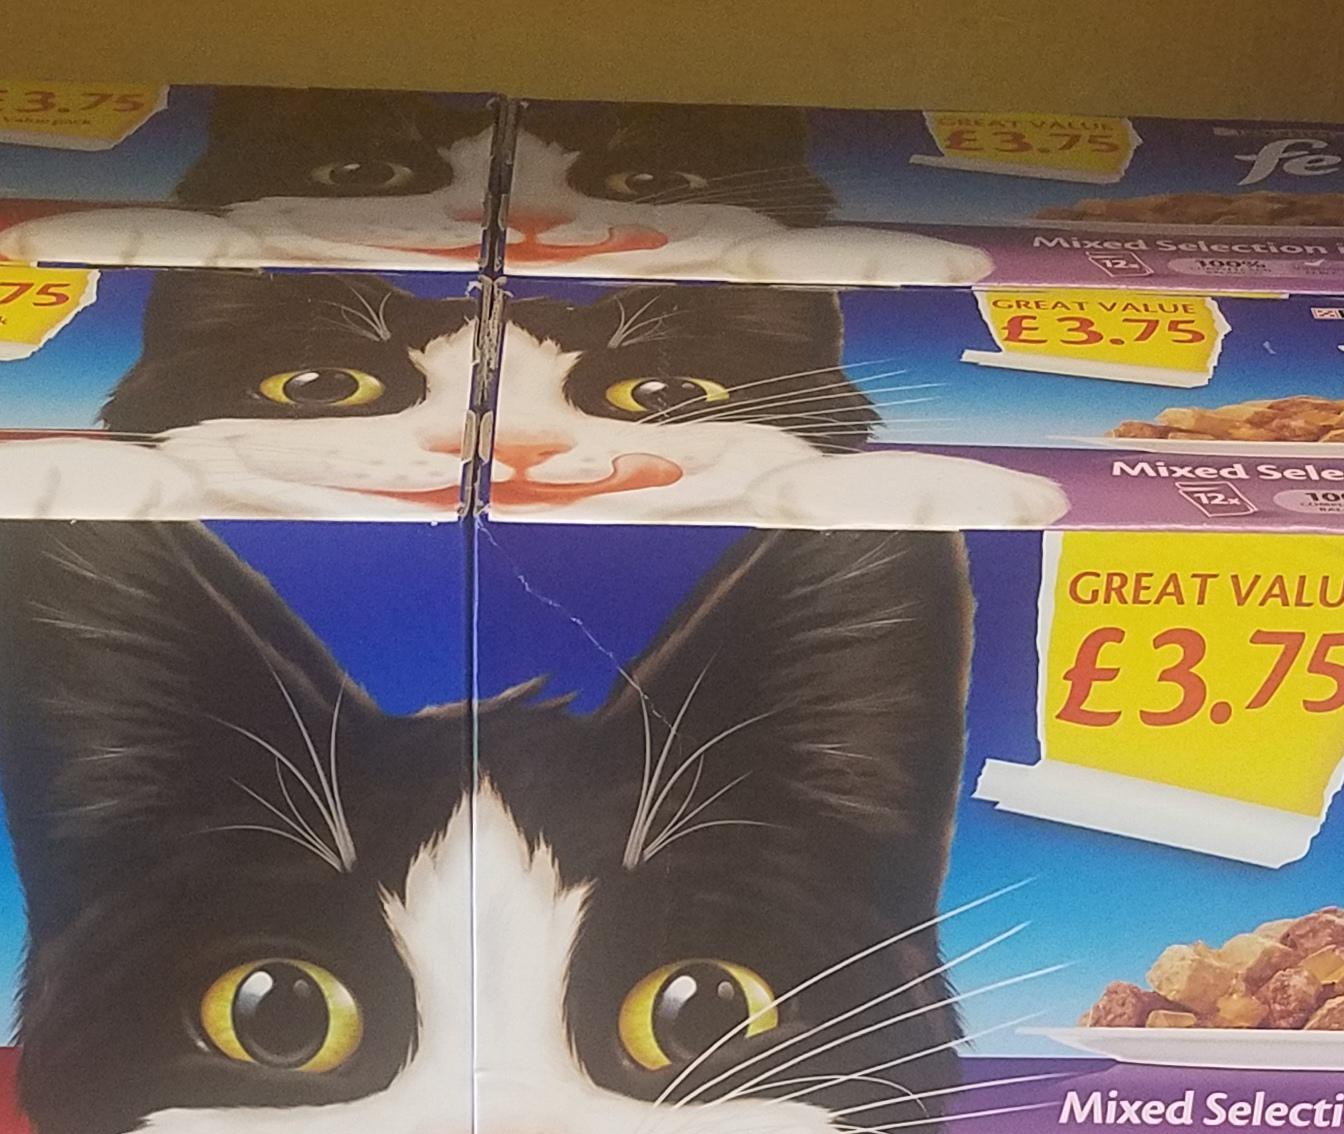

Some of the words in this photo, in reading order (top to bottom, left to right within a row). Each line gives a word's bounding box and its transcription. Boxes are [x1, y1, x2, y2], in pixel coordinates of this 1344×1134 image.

[3, 115, 50, 126] Value
[52, 116, 92, 127] pack
[939, 118, 1018, 130] GREAT
[1029, 120, 1114, 132] VALUE
[945, 129, 1120, 154] £3.75
[1032, 236, 1149, 253] Mixed
[1156, 239, 1331, 256] Selection
[992, 298, 1094, 314] GREAT
[1099, 300, 1196, 316] VALUE
[1002, 315, 1206, 346] £3.75
[1112, 461, 1249, 481] Mixed
[1193, 491, 1242, 506] 12x
[1068, 570, 1222, 608] GREAT
[1058, 1090, 1193, 1126] Mixed
